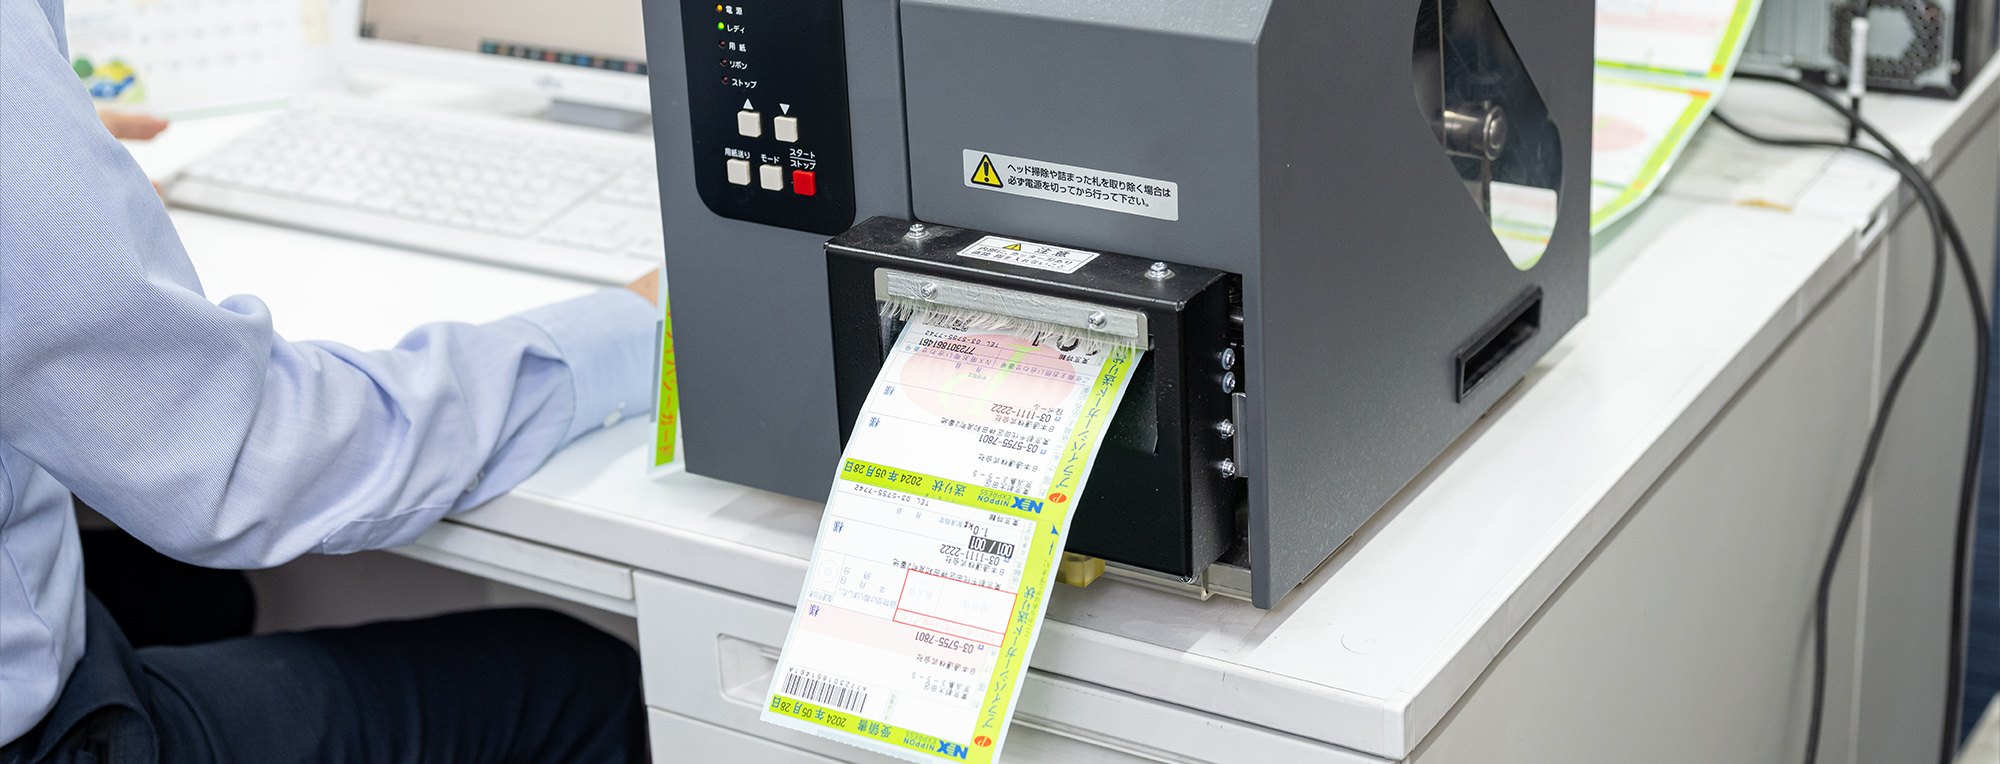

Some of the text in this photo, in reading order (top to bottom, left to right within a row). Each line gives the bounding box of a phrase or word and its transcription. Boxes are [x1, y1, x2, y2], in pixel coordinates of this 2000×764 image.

[725, 5, 744, 16] 電源
[727, 24, 745, 34] レディ
[729, 42, 747, 52] 用紙
[730, 60, 748, 70] リボン
[732, 78, 757, 89] ストップ
[725, 147, 751, 159] 用紙送り
[761, 154, 780, 164] モード
[790, 149, 816, 159] スタート
[790, 159, 816, 170] ストップ
[1007, 163, 1171, 198] ヘッド掃除や詰まった札を取り除く場合は
[1008, 176, 1150, 208] 必ず電源を切ってから行って下さい。
[924, 329, 999, 348] TEL 03-5755-7742
[917, 337, 976, 355] 772301861461
[882, 384, 896, 396] 様
[989, 402, 1052, 422] 03-1111-2222
[1032, 403, 1064, 415] 段ボール
[867, 415, 881, 428] 様
[993, 413, 1055, 432] 日本通運株式会社
[978, 433, 1039, 453] 03-5755-7801
[976, 452, 1038, 472] 日本通運株式会社
[853, 483, 911, 502] 03-5755-7742
[930, 478, 967, 497] 送り状
[978, 488, 1012, 500] EXPRESS
[914, 496, 930, 506] TEL
[976, 494, 1010, 506] NIPPON
[830, 520, 845, 533] 様
[938, 543, 1001, 566] 03-1111-2222
[944, 554, 1005, 576] 日本通運株式会社
[806, 603, 821, 617] 様
[913, 630, 975, 654] 03-5755-7801
[915, 653, 976, 676] 日本通運株式会社
[980, 585, 1037, 730] プライバシーガード送り状
[787, 665, 867, 691] A772301861461A
[855, 718, 892, 738] 受領書
[902, 736, 935, 751] NIPPON
[904, 730, 937, 744] EXPRESS
